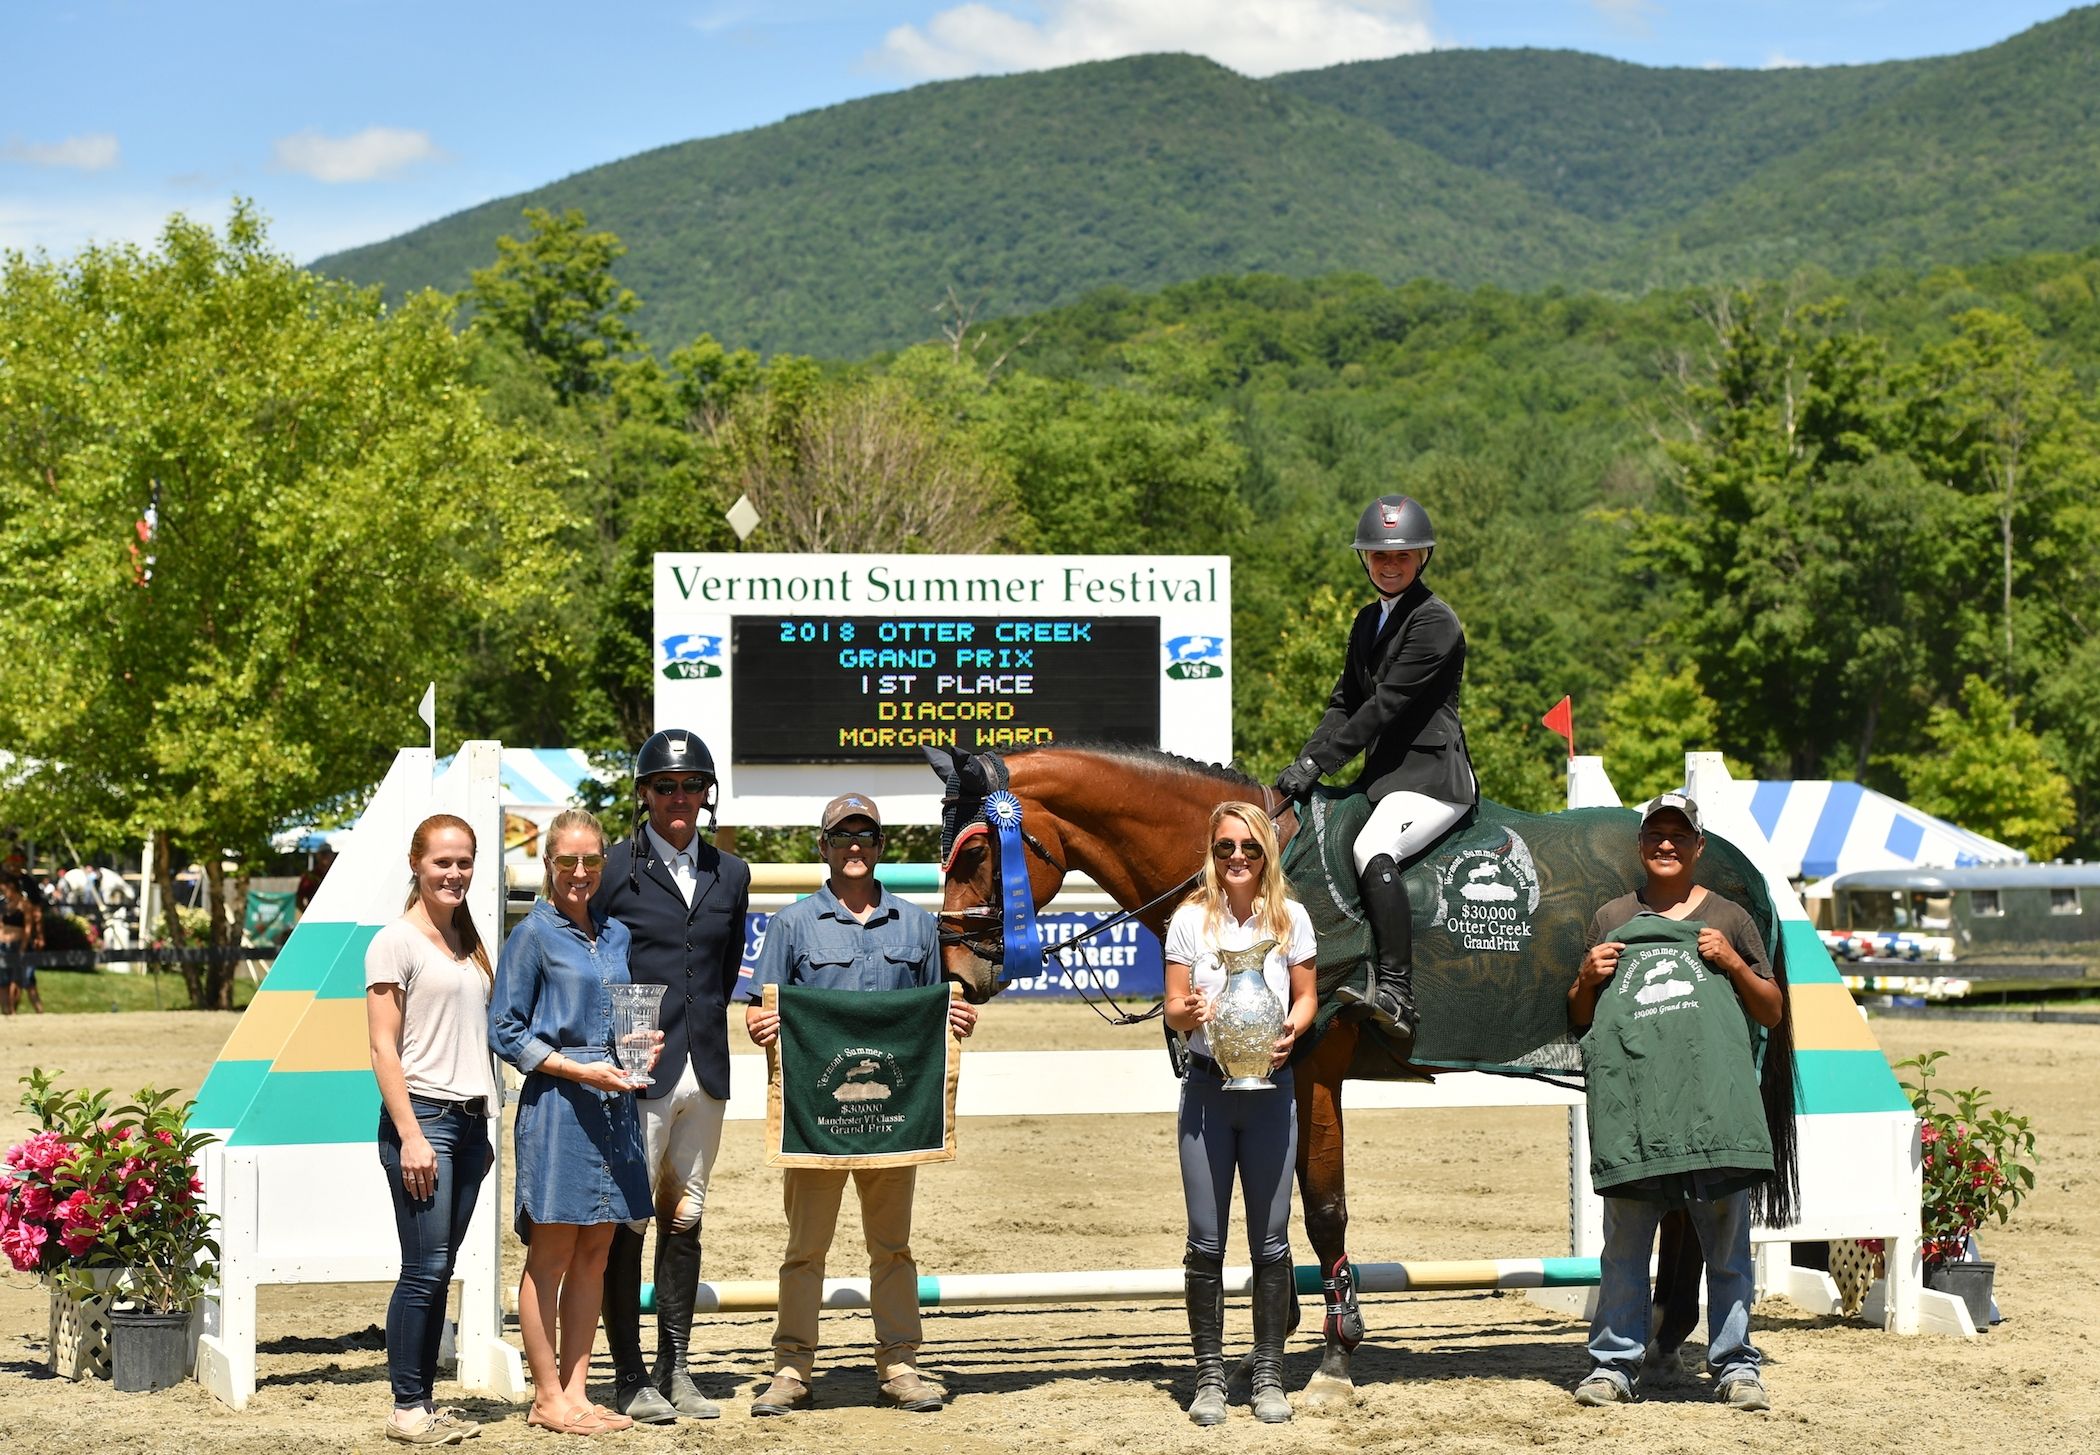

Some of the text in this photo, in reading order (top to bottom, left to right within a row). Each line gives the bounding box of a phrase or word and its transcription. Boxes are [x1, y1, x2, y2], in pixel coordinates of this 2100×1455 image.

[670, 565, 1218, 603] Vermont Summer Festival
[780, 622, 1092, 642] 2018 OTTER CREEK
[839, 649, 1034, 668] GRAND PRIX
[677, 664, 709, 678] VSF
[1180, 664, 1211, 678] VSF
[862, 675, 1034, 694] 1ST PLACE
[878, 702, 1015, 720] DIACORD
[839, 728, 1054, 747] MORGAN WARD
[1443, 849, 1530, 890] Vermont Summer Festival
[1461, 903, 1517, 921] $30,000
[1110, 921, 1140, 943] VT
[1447, 917, 1532, 936] Otter Creek
[1463, 934, 1520, 951] Grand Prix
[1060, 946, 1138, 967] STREET
[1619, 947, 1707, 995] Vermont Summer Festival
[1658, 1001, 1681, 1014] Grand
[1681, 1000, 1700, 1009] Prix
[816, 1053, 845, 1089] Vermont
[843, 1047, 884, 1058] Summer
[840, 1103, 883, 1115] $30,000
[817, 1112, 906, 1126] Manchester VT Classic
[830, 1123, 893, 1134] Grand Prix
